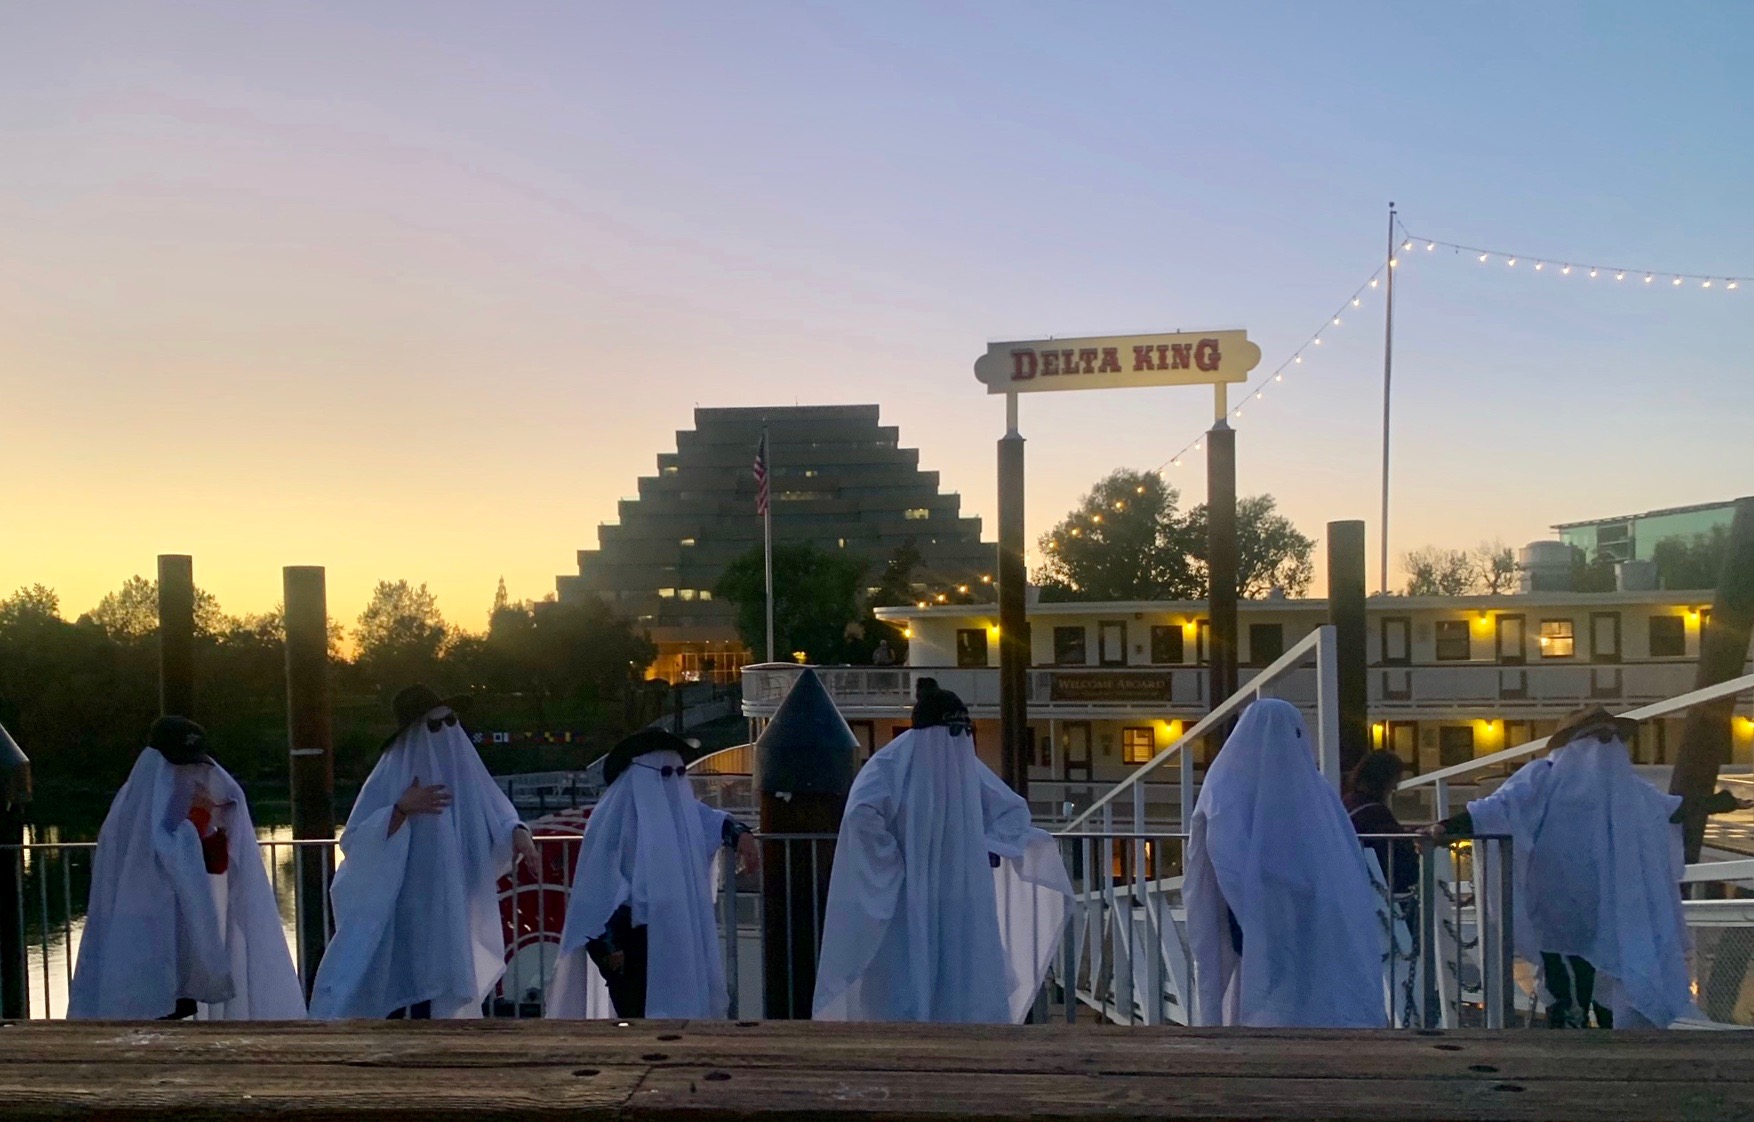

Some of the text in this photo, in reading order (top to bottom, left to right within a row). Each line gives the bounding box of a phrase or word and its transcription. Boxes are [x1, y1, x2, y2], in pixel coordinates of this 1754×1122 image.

[1010, 338, 1221, 381] DELTA KING
[1058, 678, 1166, 689] WELCOME ABOARD
